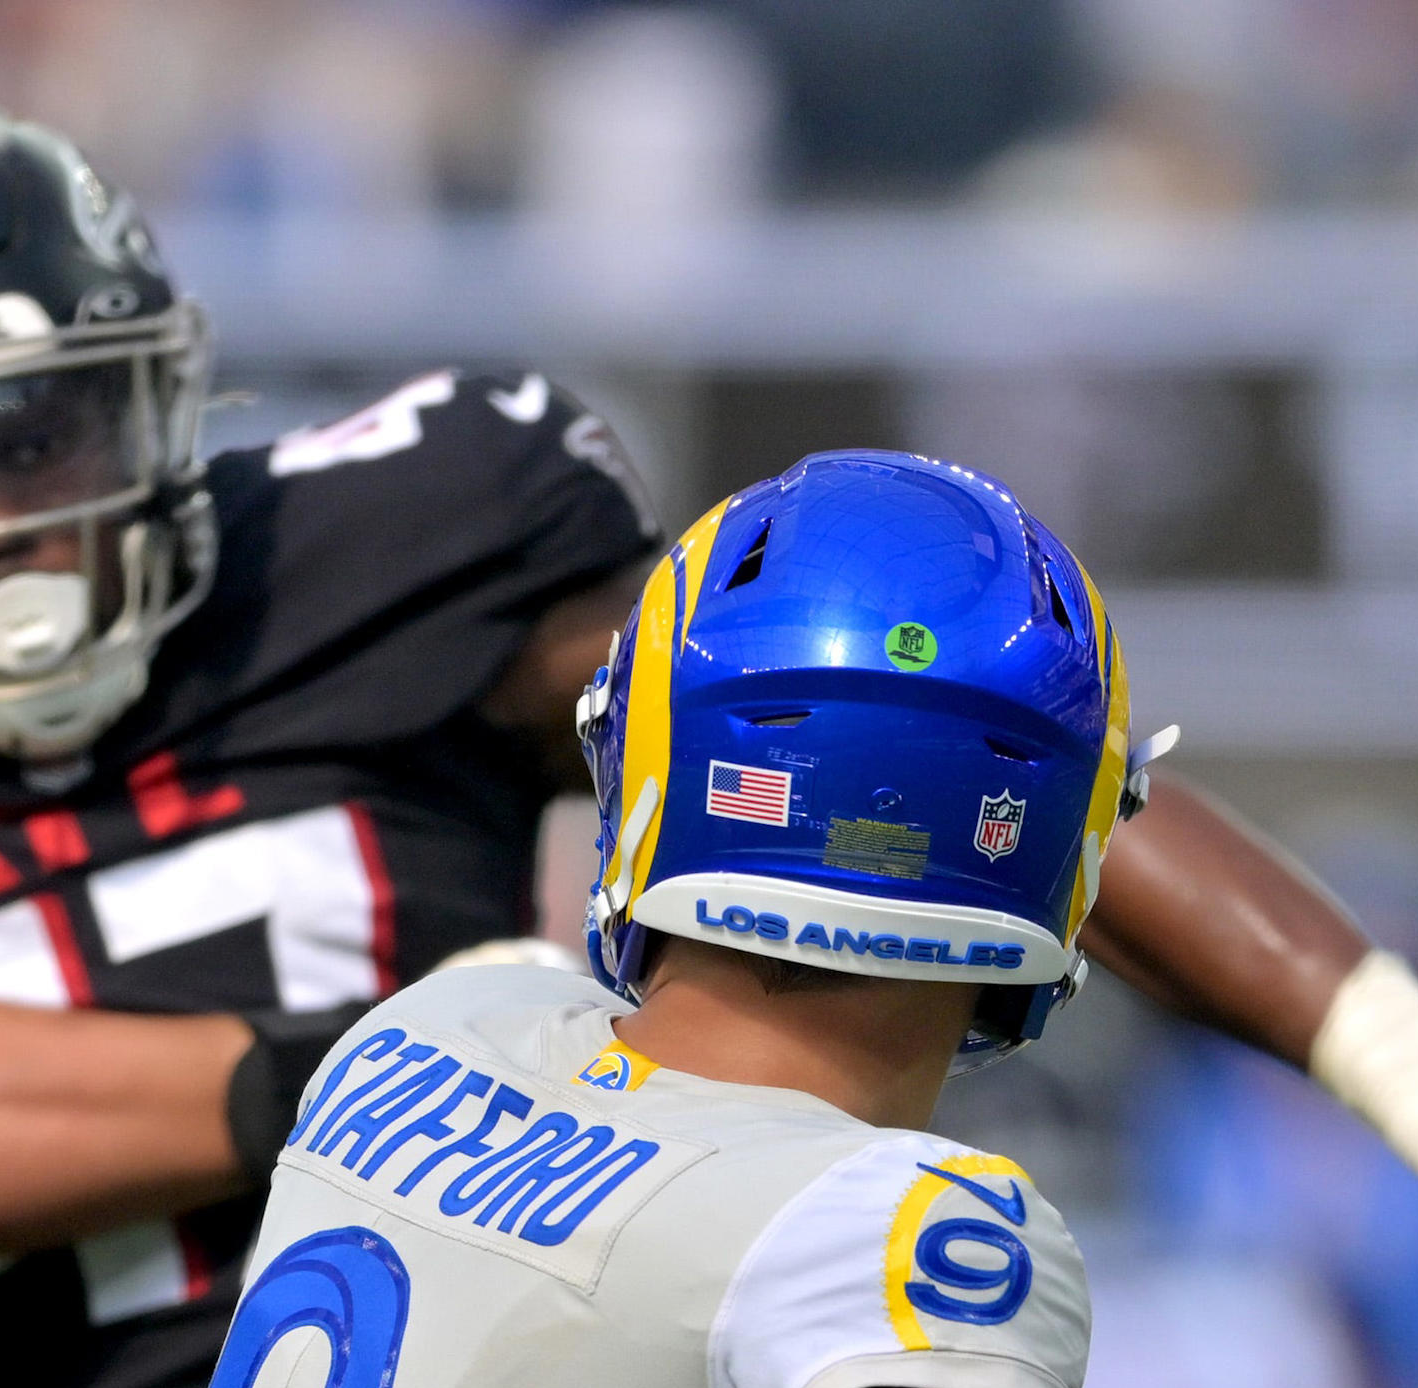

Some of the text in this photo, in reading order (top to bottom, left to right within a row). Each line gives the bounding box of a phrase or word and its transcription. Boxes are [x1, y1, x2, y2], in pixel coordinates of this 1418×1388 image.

[981, 821, 1013, 851] NFL
[696, 898, 1026, 969] LOS ANGELES
[285, 1027, 662, 1247] STAFFORD
[904, 1217, 1033, 1327] 9
